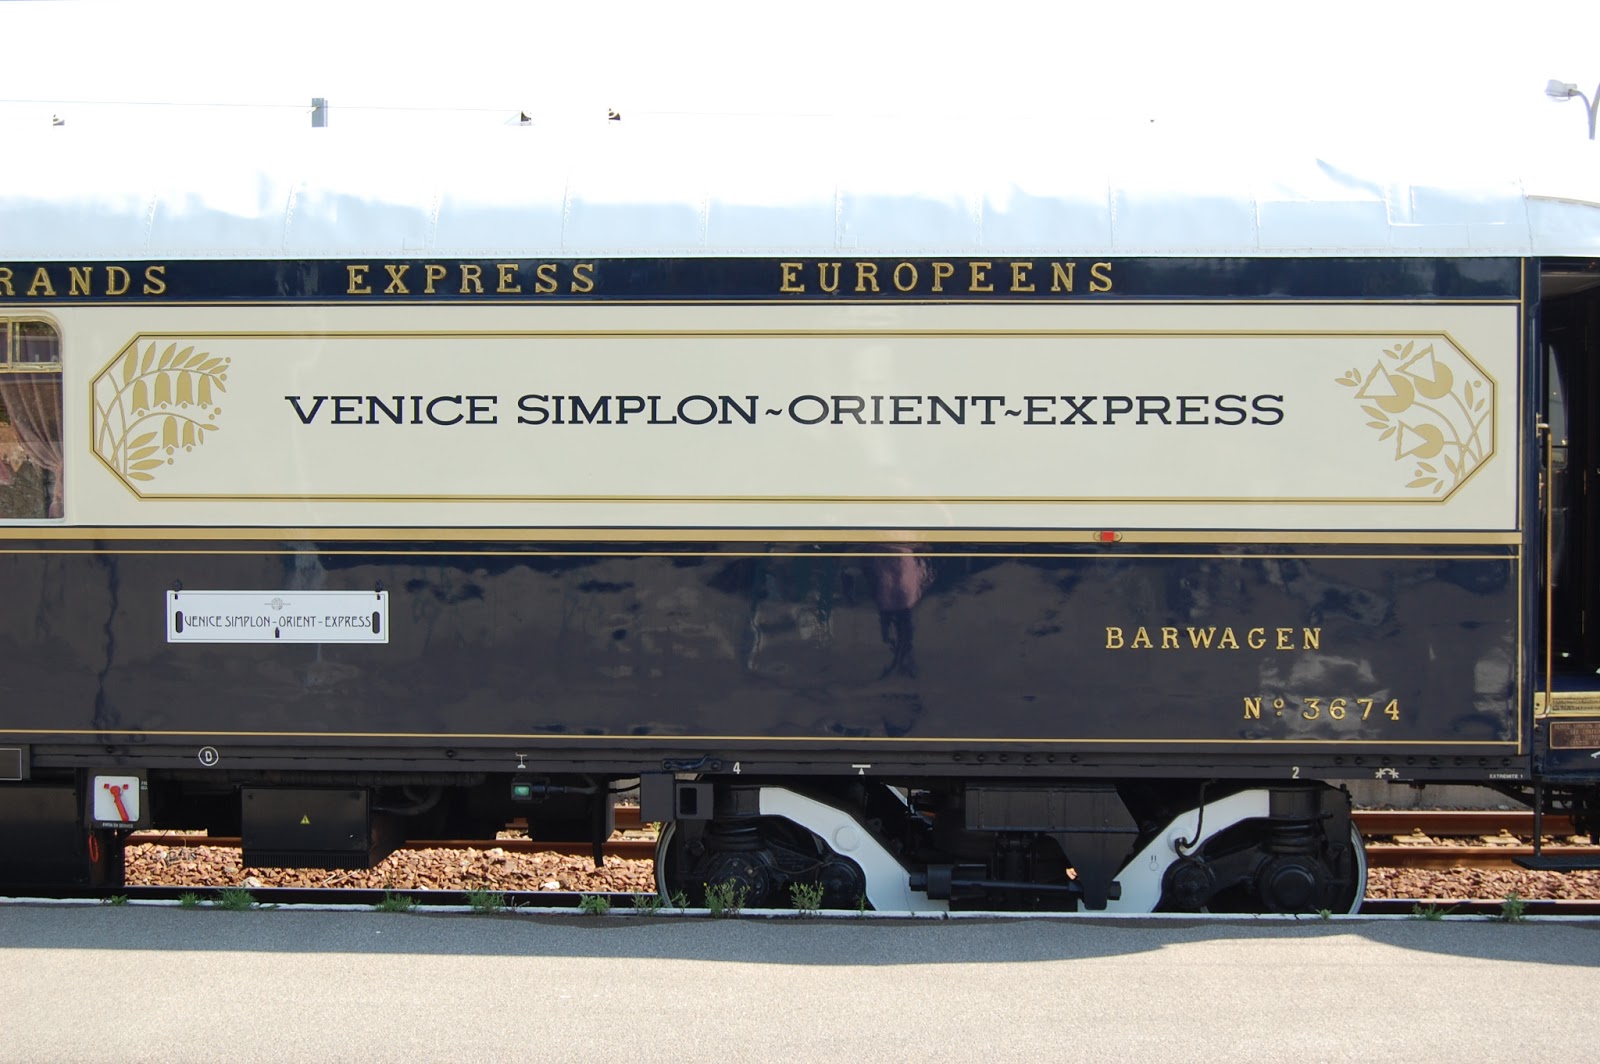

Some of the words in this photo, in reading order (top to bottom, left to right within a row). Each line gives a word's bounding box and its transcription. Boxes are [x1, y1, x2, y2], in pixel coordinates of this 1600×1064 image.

[0, 265, 167, 296] RANDS
[346, 263, 594, 294] EXPRESS
[779, 262, 1113, 292] EUROPEENS
[284, 394, 498, 426] VENICE
[184, 615, 222, 628] VENICE
[1105, 626, 1322, 650] BARWAGEN
[1302, 697, 1400, 720] 3674
[205, 750, 213, 762] D
[732, 761, 742, 775] 4
[1291, 766, 1300, 779] 2
